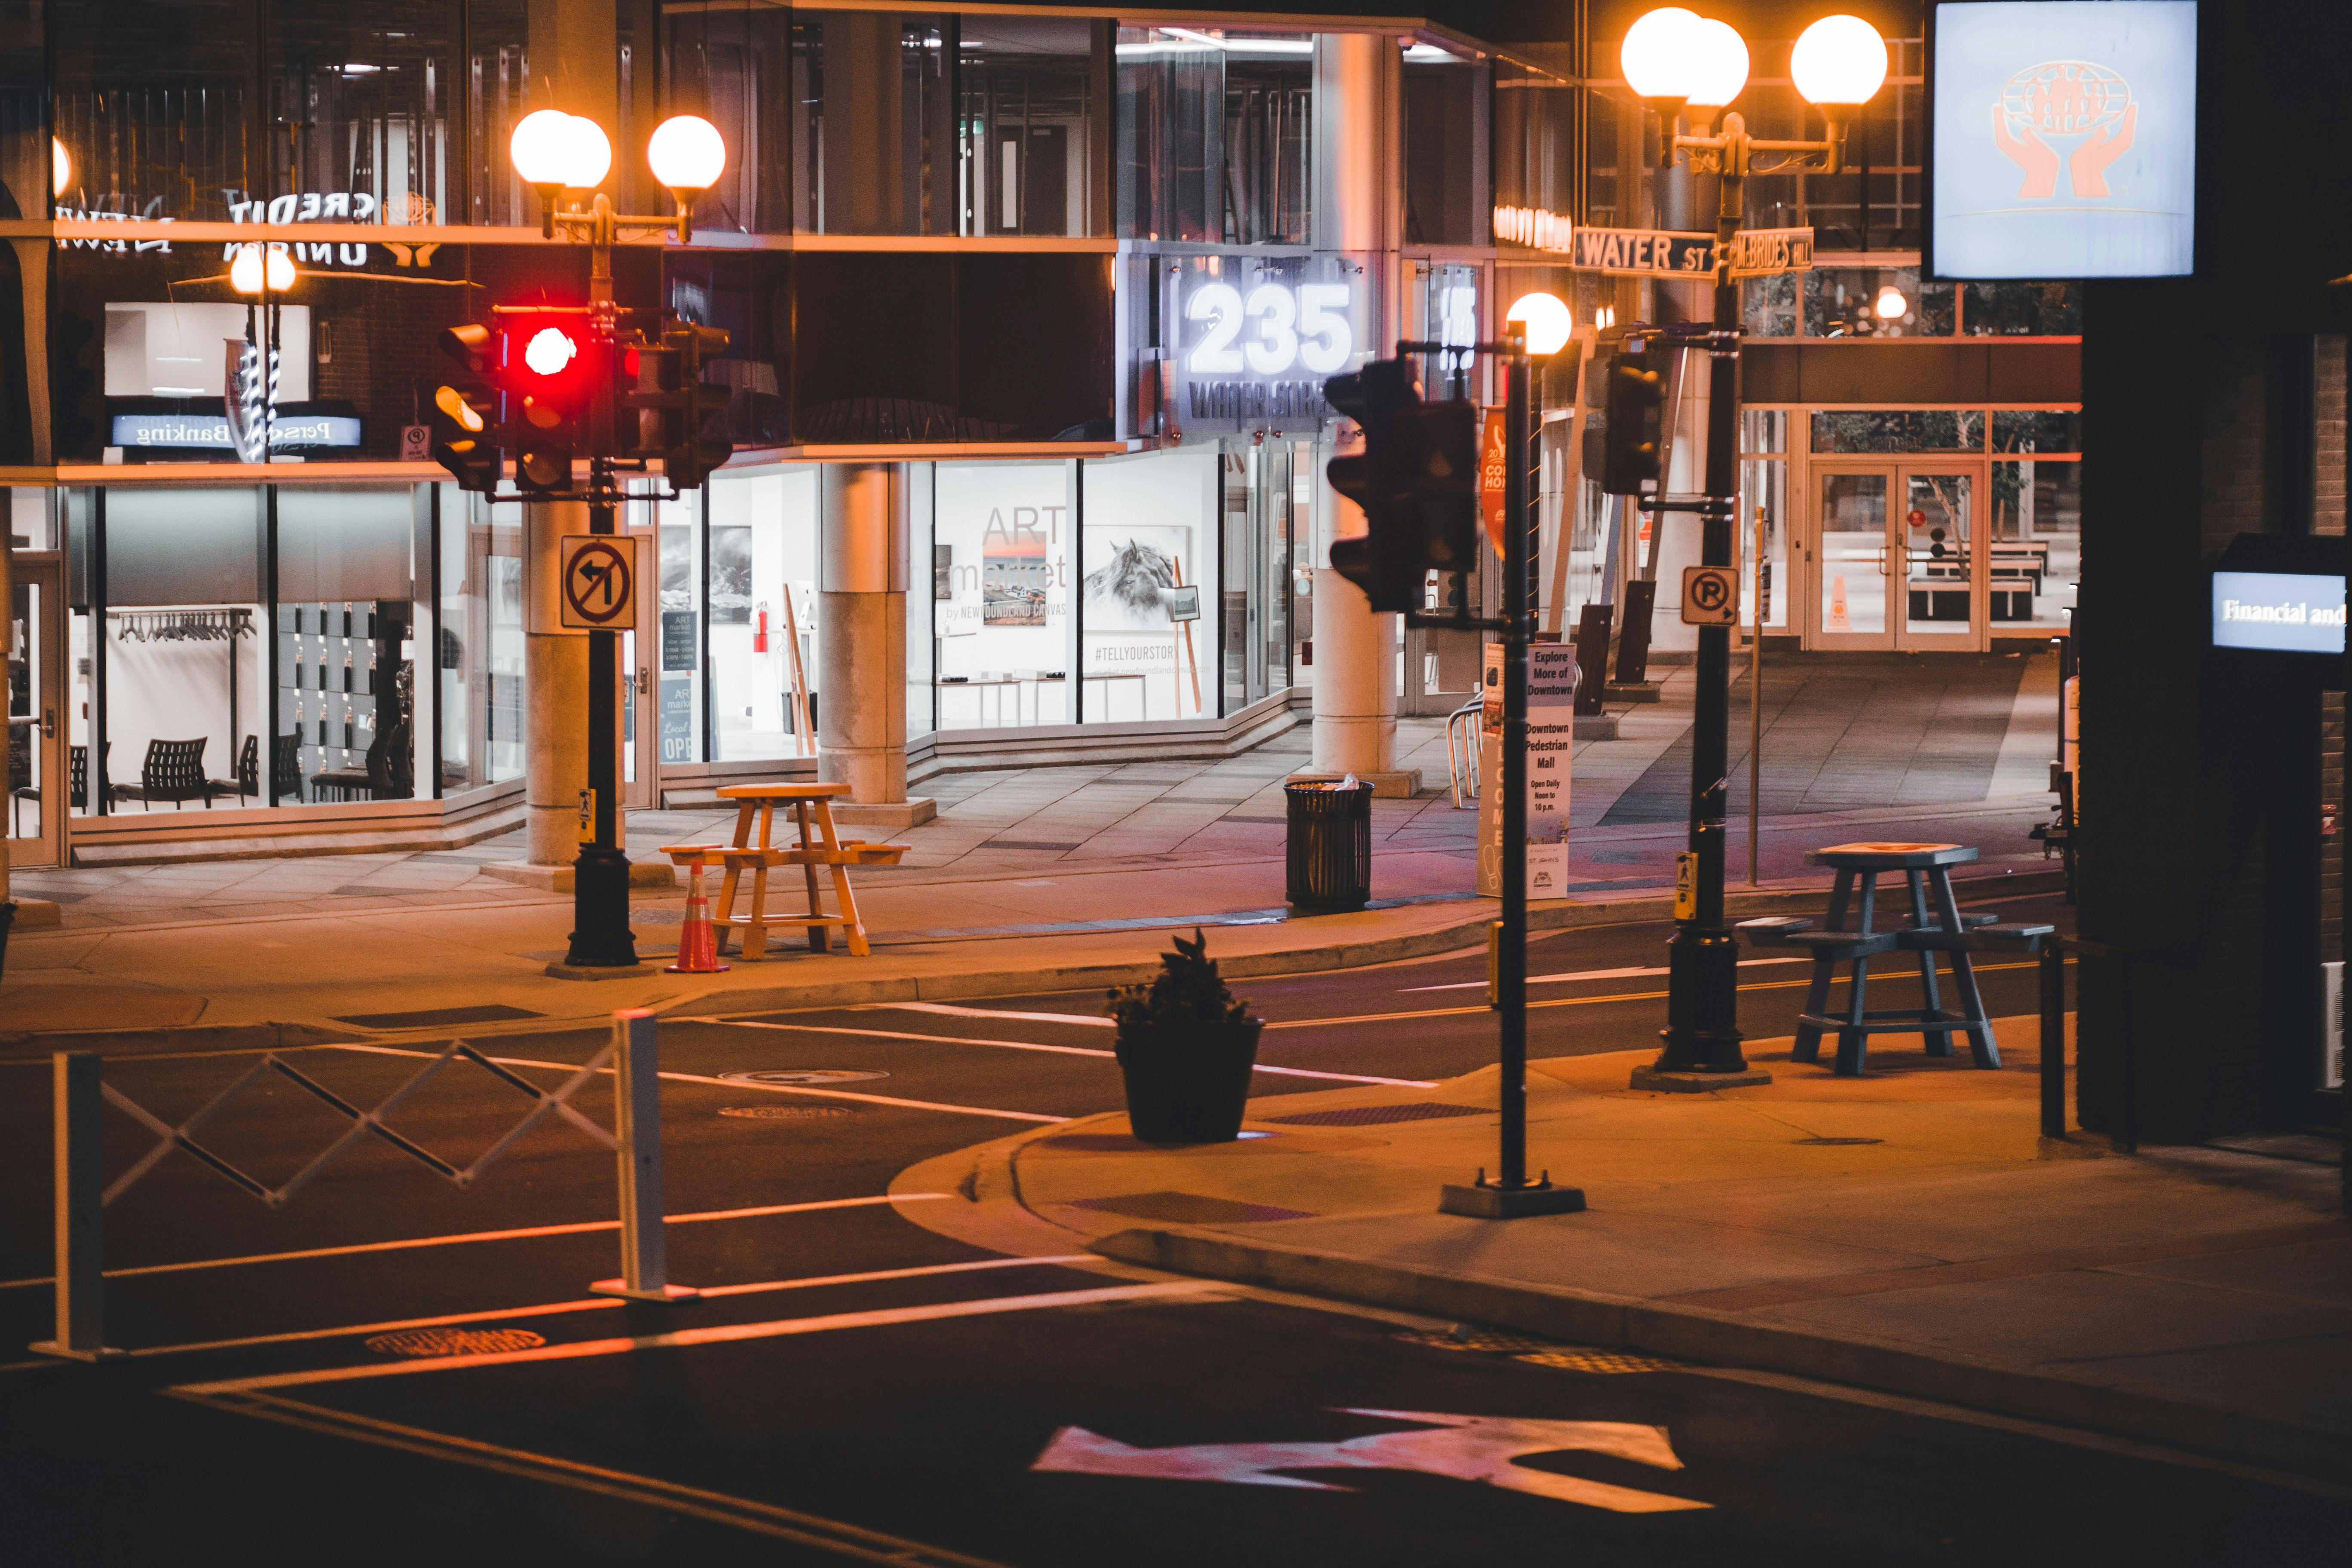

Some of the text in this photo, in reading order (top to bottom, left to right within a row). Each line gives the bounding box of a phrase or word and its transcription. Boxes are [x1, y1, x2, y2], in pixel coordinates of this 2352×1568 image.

[1583, 233, 1706, 271] WATER ST
[1793, 242, 1811, 266] HILL
[1189, 284, 1352, 374] 235
[1188, 380, 1266, 419] WATER
[1485, 464, 1505, 476] CO
[1485, 477, 1505, 488] HO
[982, 505, 1066, 546] ART
[949, 554, 1066, 591] market
[946, 603, 1066, 620] by NEWFOUNDLAND CANVAS
[2223, 600, 2347, 625] Financial and
[1096, 646, 1179, 661] #TELLYOURSTORY
[1535, 651, 1568, 665] Explore
[1534, 667, 1568, 678] More of
[675, 689, 691, 699] AR
[1528, 685, 1573, 695] Downtown
[663, 721, 688, 734] Local
[1525, 723, 1569, 734] Downtown
[1537, 756, 1555, 769] Mall
[1531, 779, 1560, 789] Open Daily
[1543, 804, 1555, 813] p.m.
